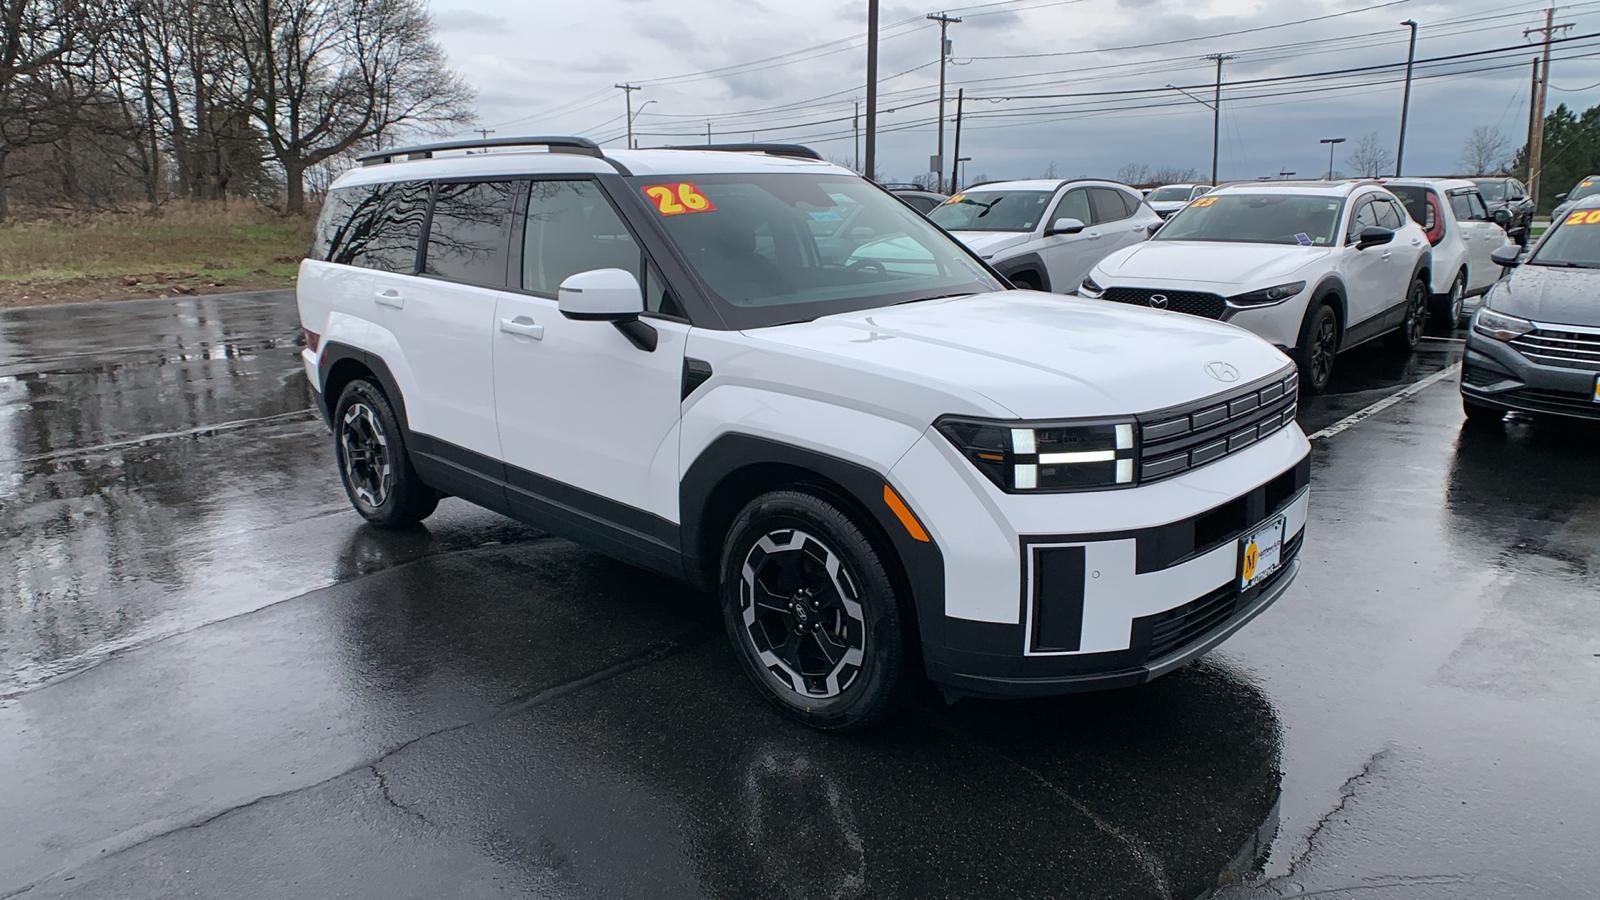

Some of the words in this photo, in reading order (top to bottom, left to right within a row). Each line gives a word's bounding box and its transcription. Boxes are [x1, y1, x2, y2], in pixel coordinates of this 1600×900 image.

[647, 183, 709, 213] 26
[1565, 211, 1600, 224] 20
[1245, 551, 1256, 573] M
